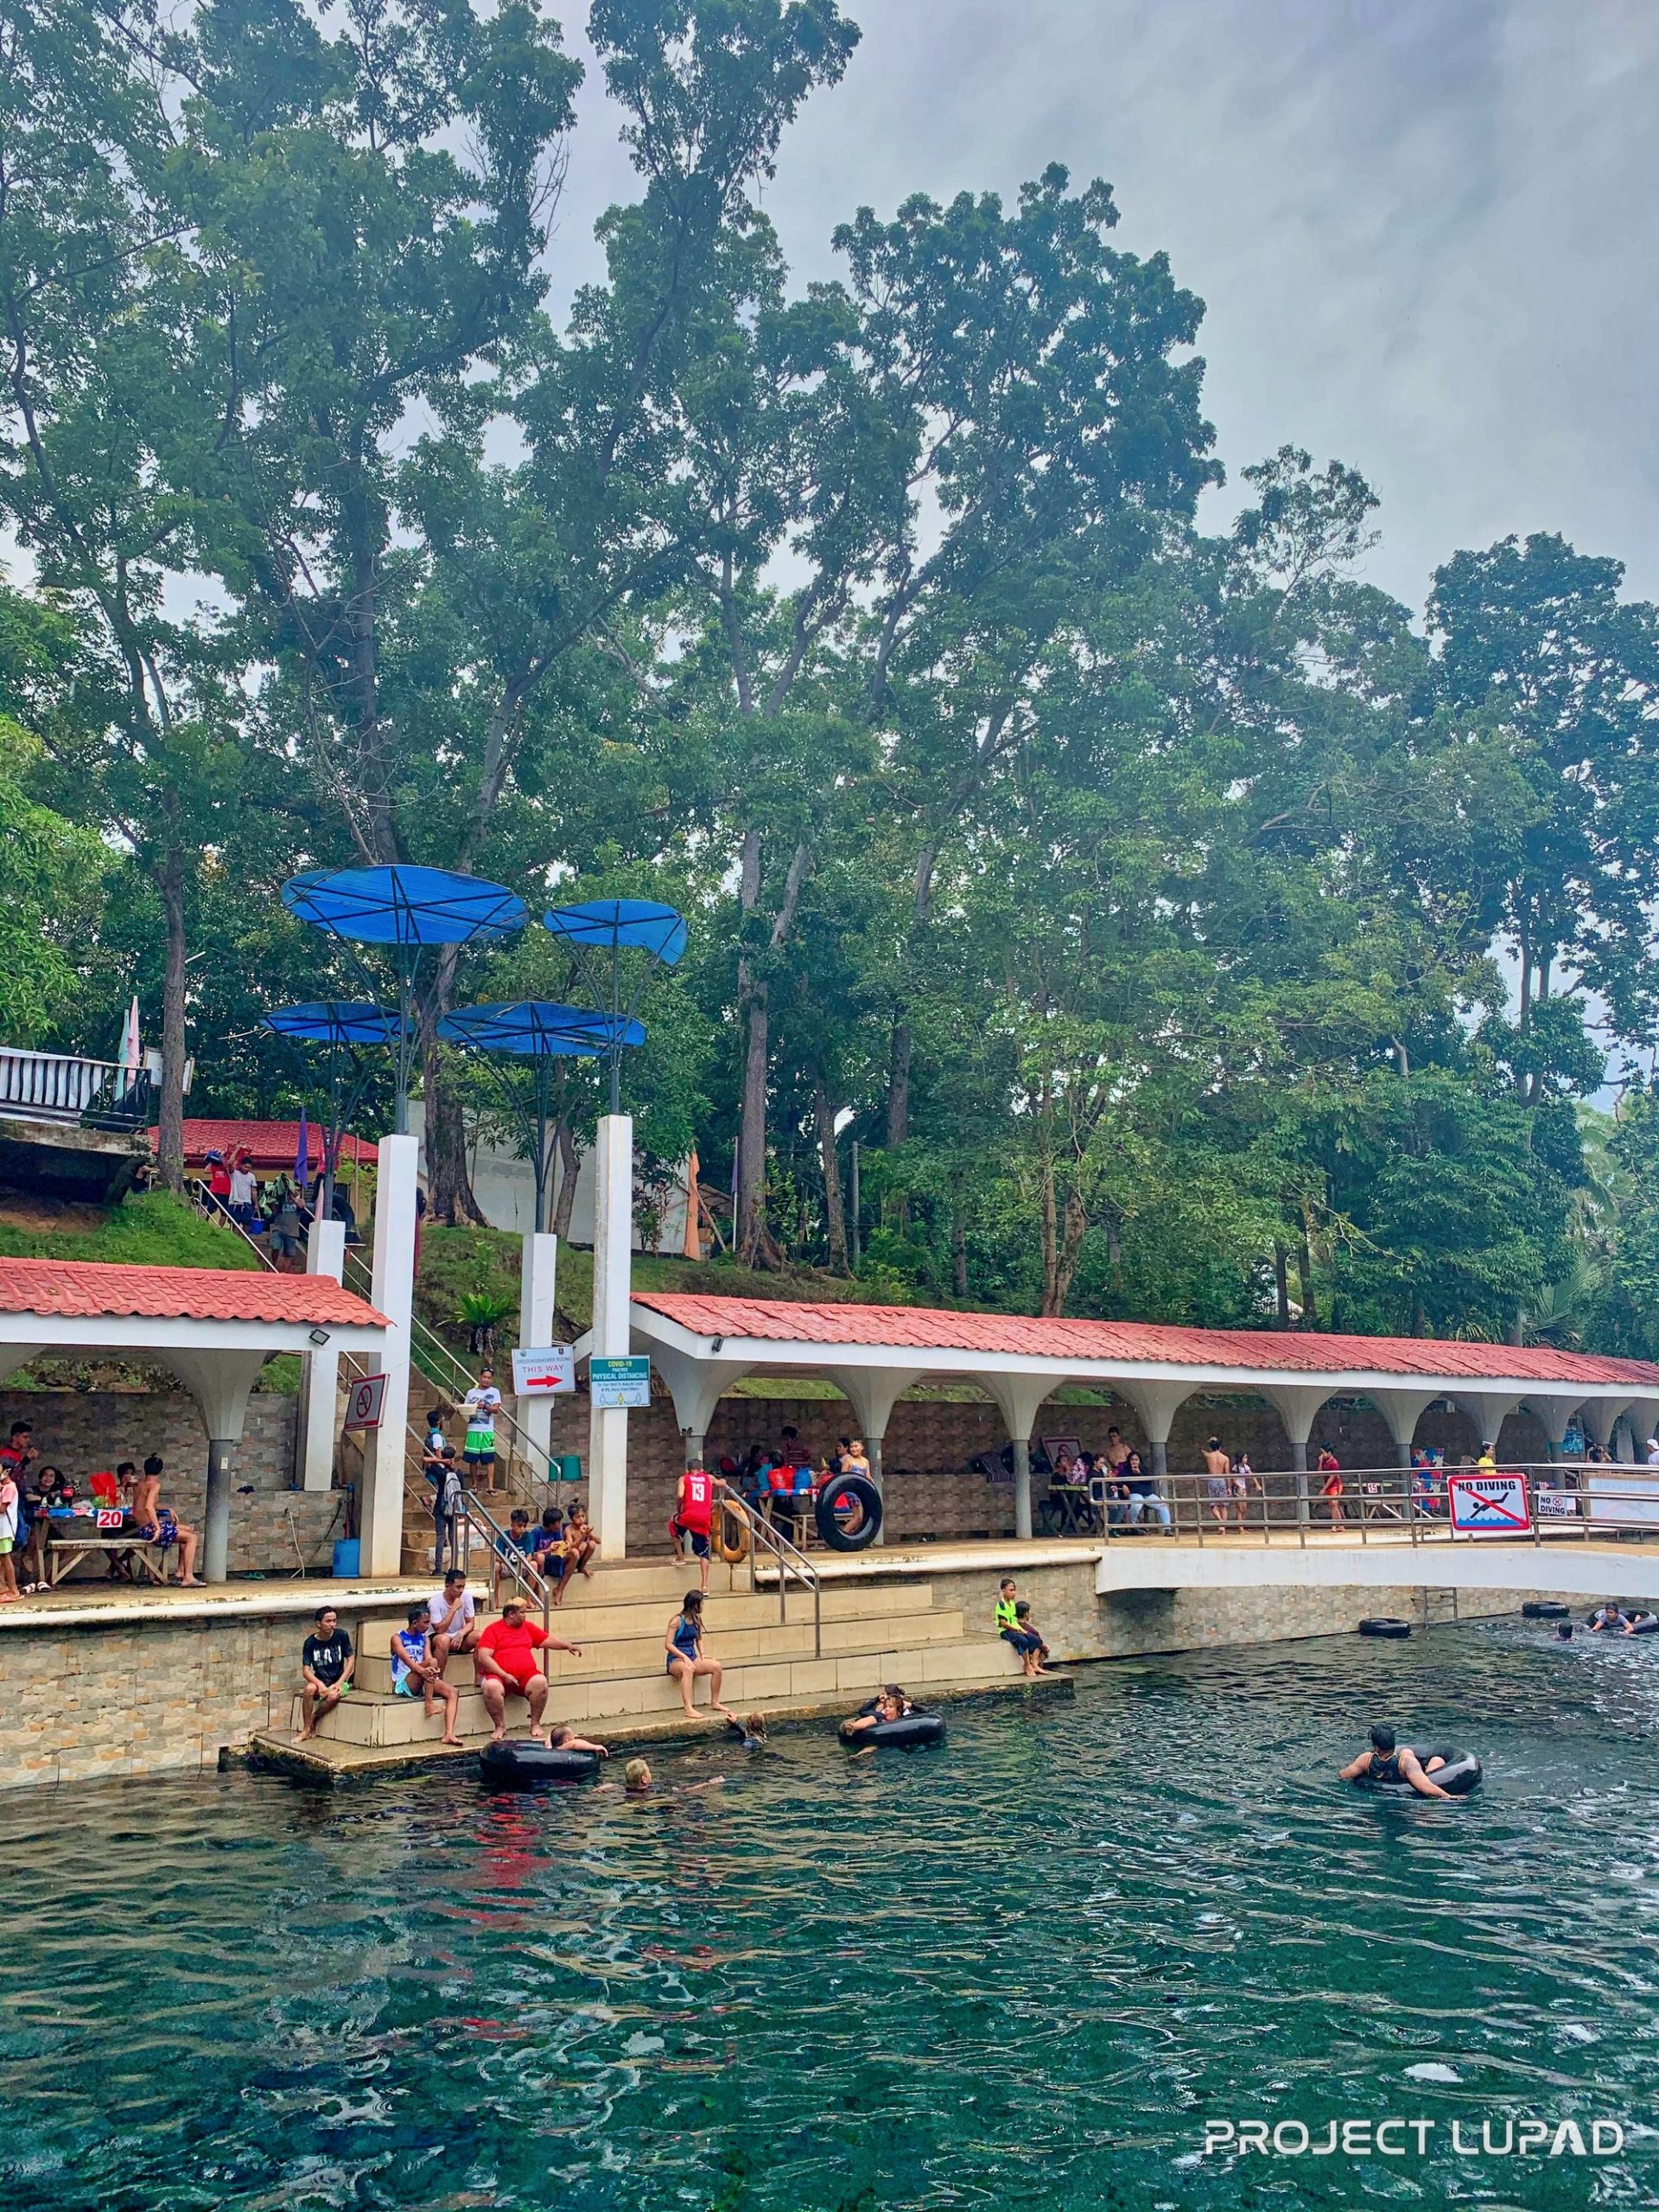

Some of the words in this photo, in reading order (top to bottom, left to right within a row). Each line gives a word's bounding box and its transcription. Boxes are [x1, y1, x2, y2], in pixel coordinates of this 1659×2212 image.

[1458, 1482, 1473, 1491] NO
[1476, 1480, 1516, 1491] DIVING
[691, 1483, 705, 1502] 13
[1541, 1505, 1566, 1515] DIVING
[99, 1511, 122, 1527] 20
